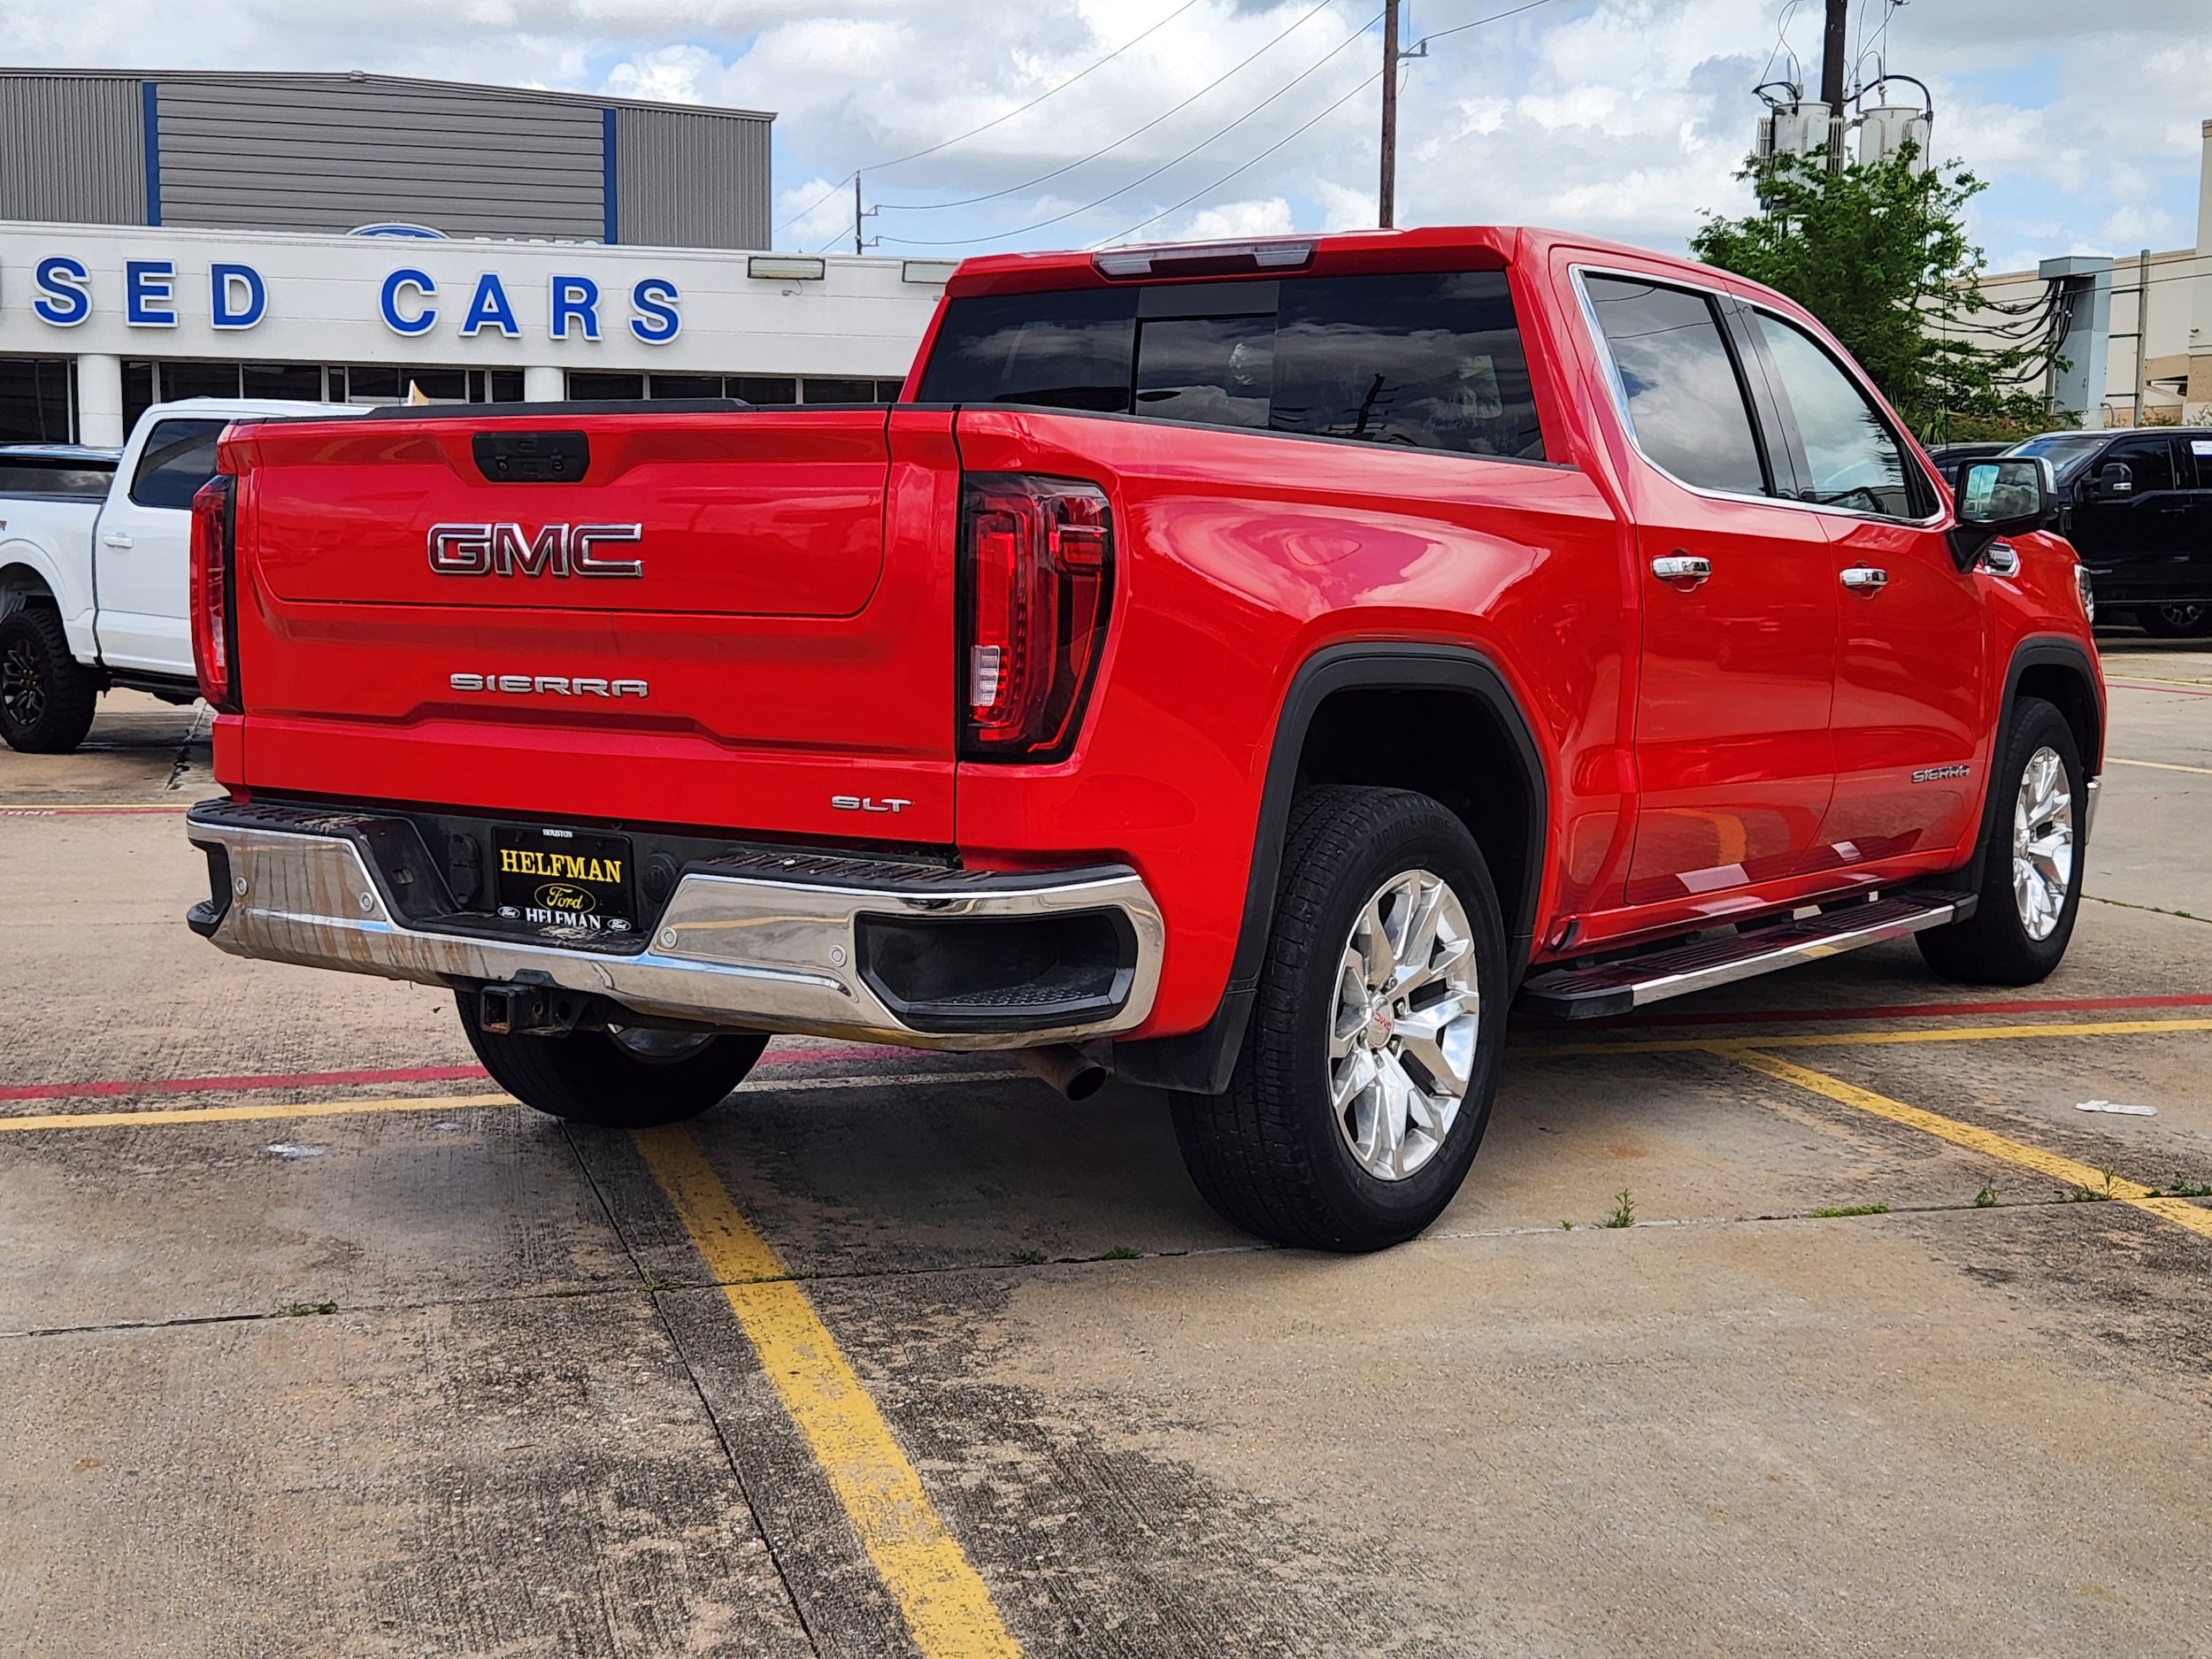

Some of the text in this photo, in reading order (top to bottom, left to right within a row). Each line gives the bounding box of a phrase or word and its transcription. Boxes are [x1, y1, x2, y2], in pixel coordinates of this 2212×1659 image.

[379, 266, 682, 346] CARS
[426, 522, 644, 578] GMC
[449, 672, 649, 699] SIERRA
[1911, 764, 1971, 784] SIERRA
[832, 795, 912, 813] SLT
[500, 849, 623, 883] HELFMAN
[546, 886, 584, 910] Ford
[525, 907, 602, 930] HELFMAN
